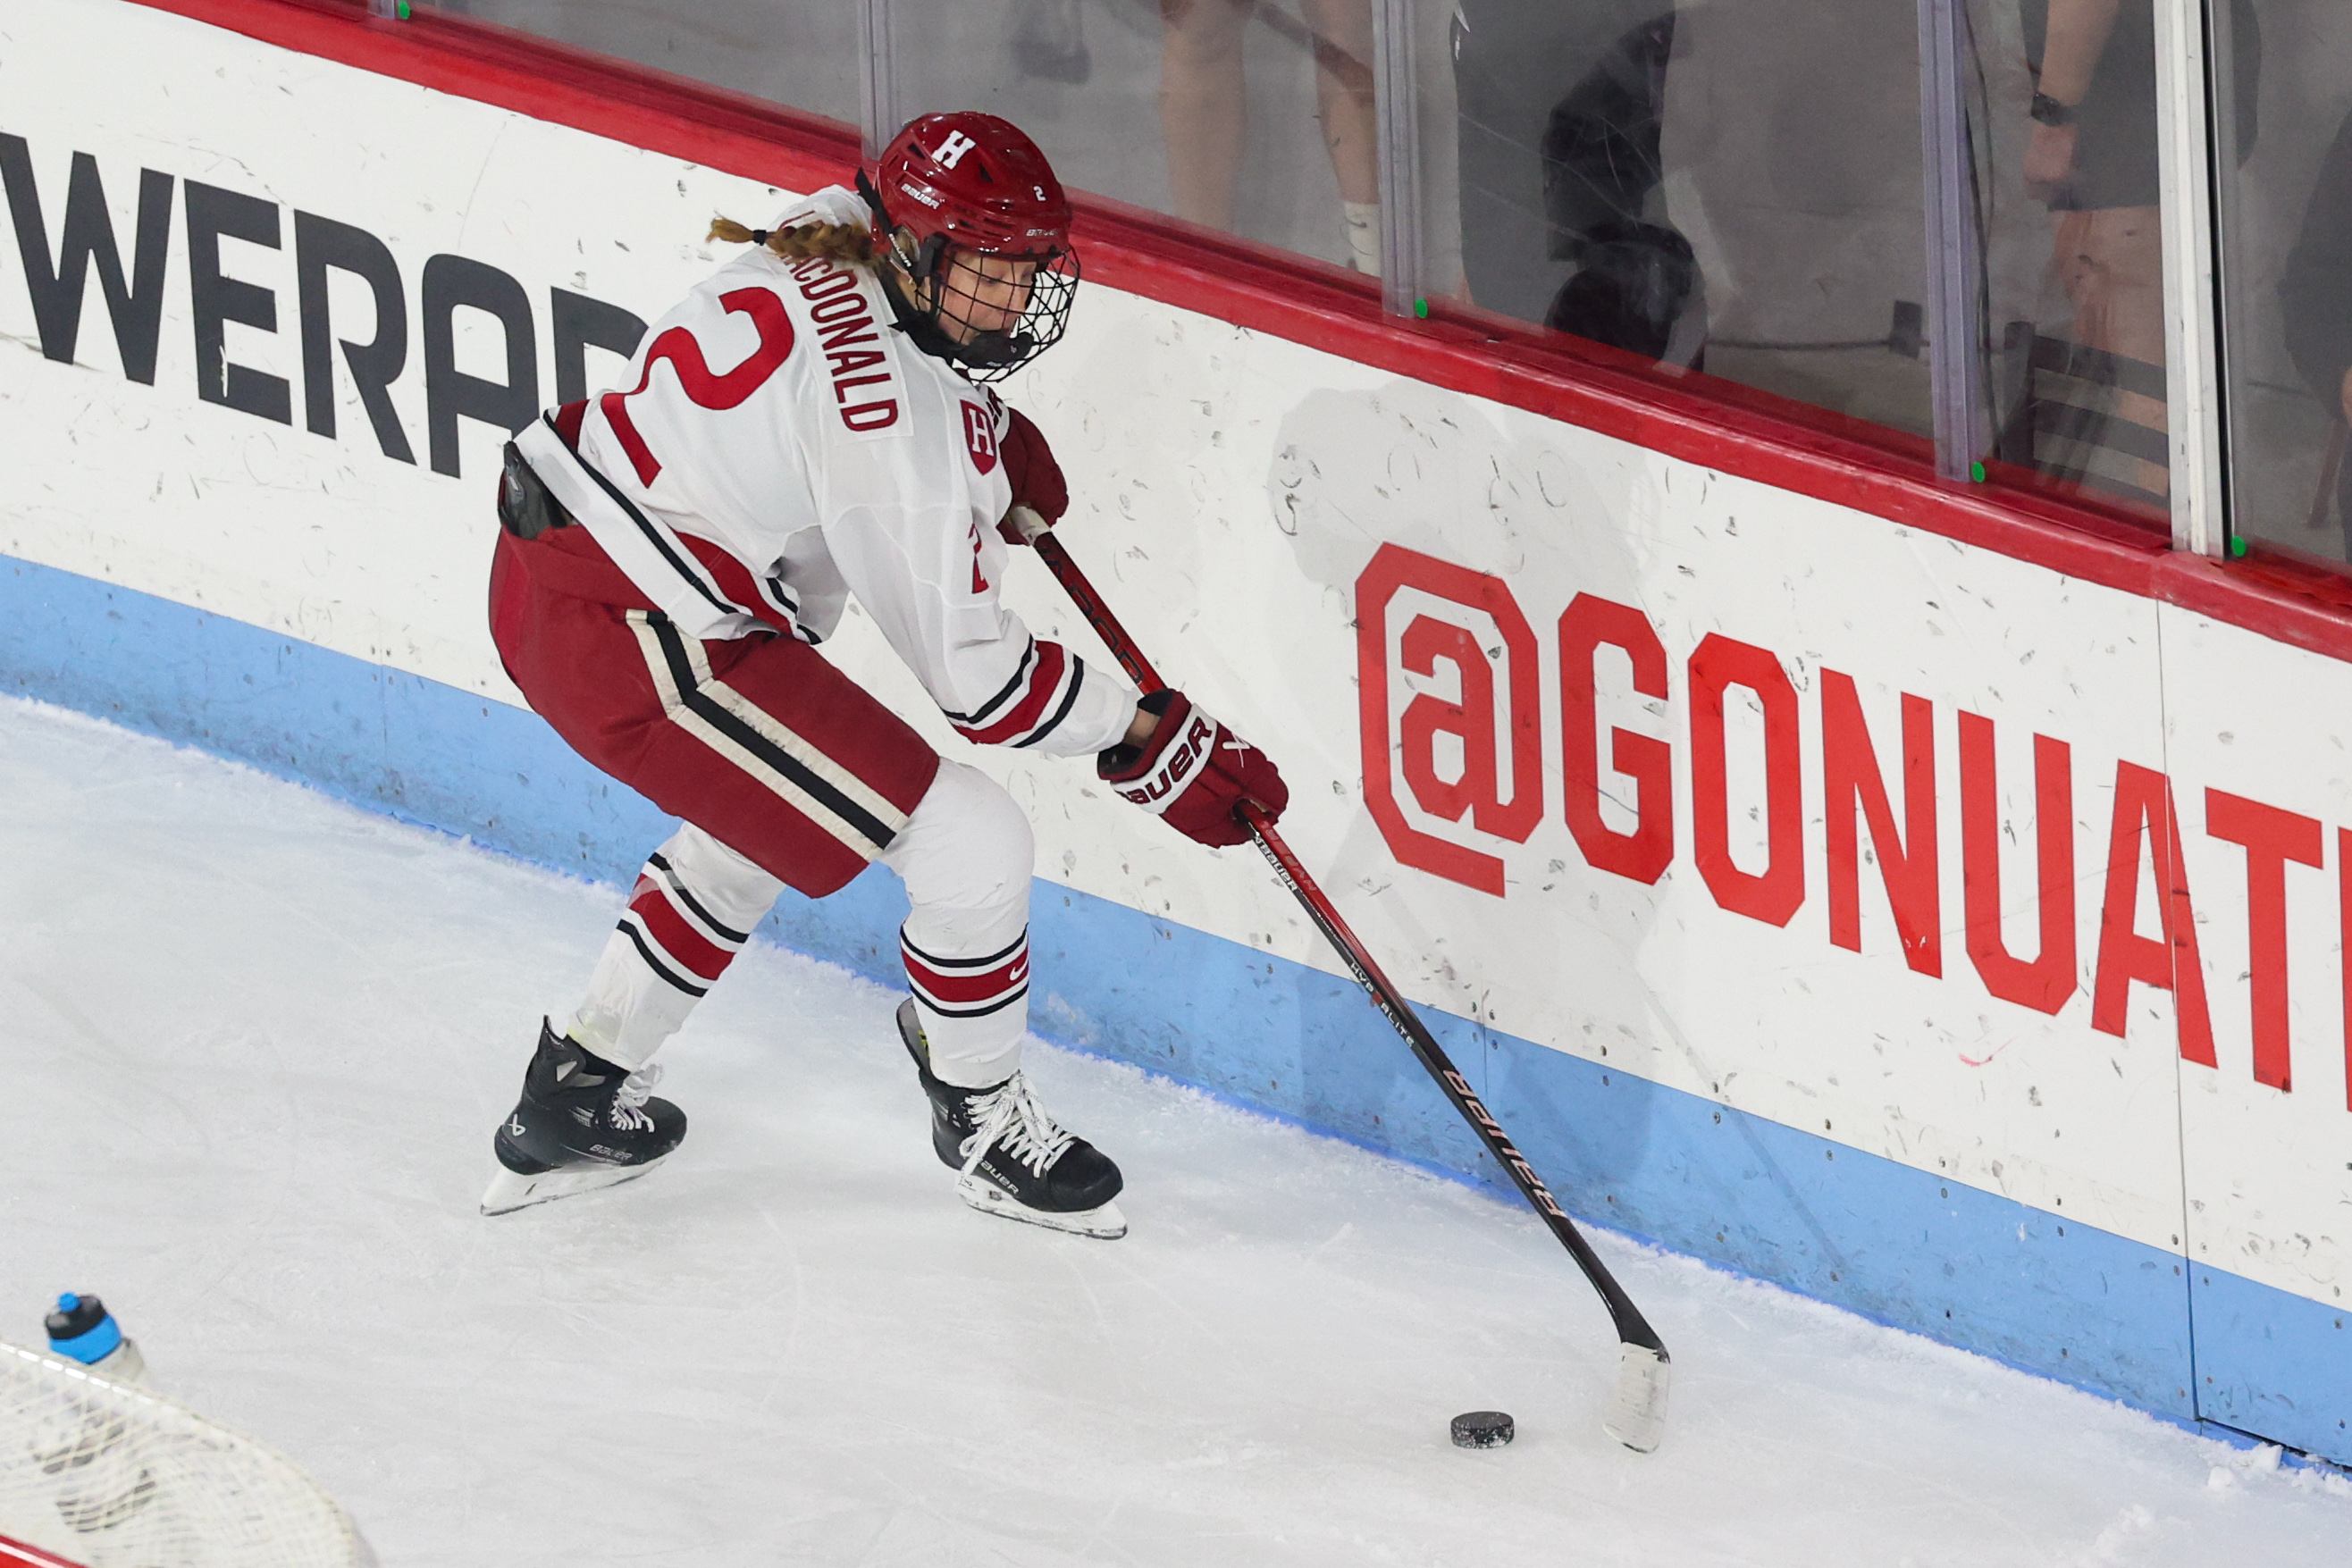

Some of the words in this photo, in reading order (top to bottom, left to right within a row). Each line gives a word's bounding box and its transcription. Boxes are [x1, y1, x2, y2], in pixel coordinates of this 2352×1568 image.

[931, 130, 976, 170] H
[901, 182, 940, 210] BAUER
[1033, 184, 1046, 202] 2
[601, 286, 794, 489] 2
[968, 407, 995, 457] H
[1114, 716, 1213, 804] AUER
[1354, 541, 2352, 1113] @GONUAT
[980, 1160, 1020, 1195] AUER
